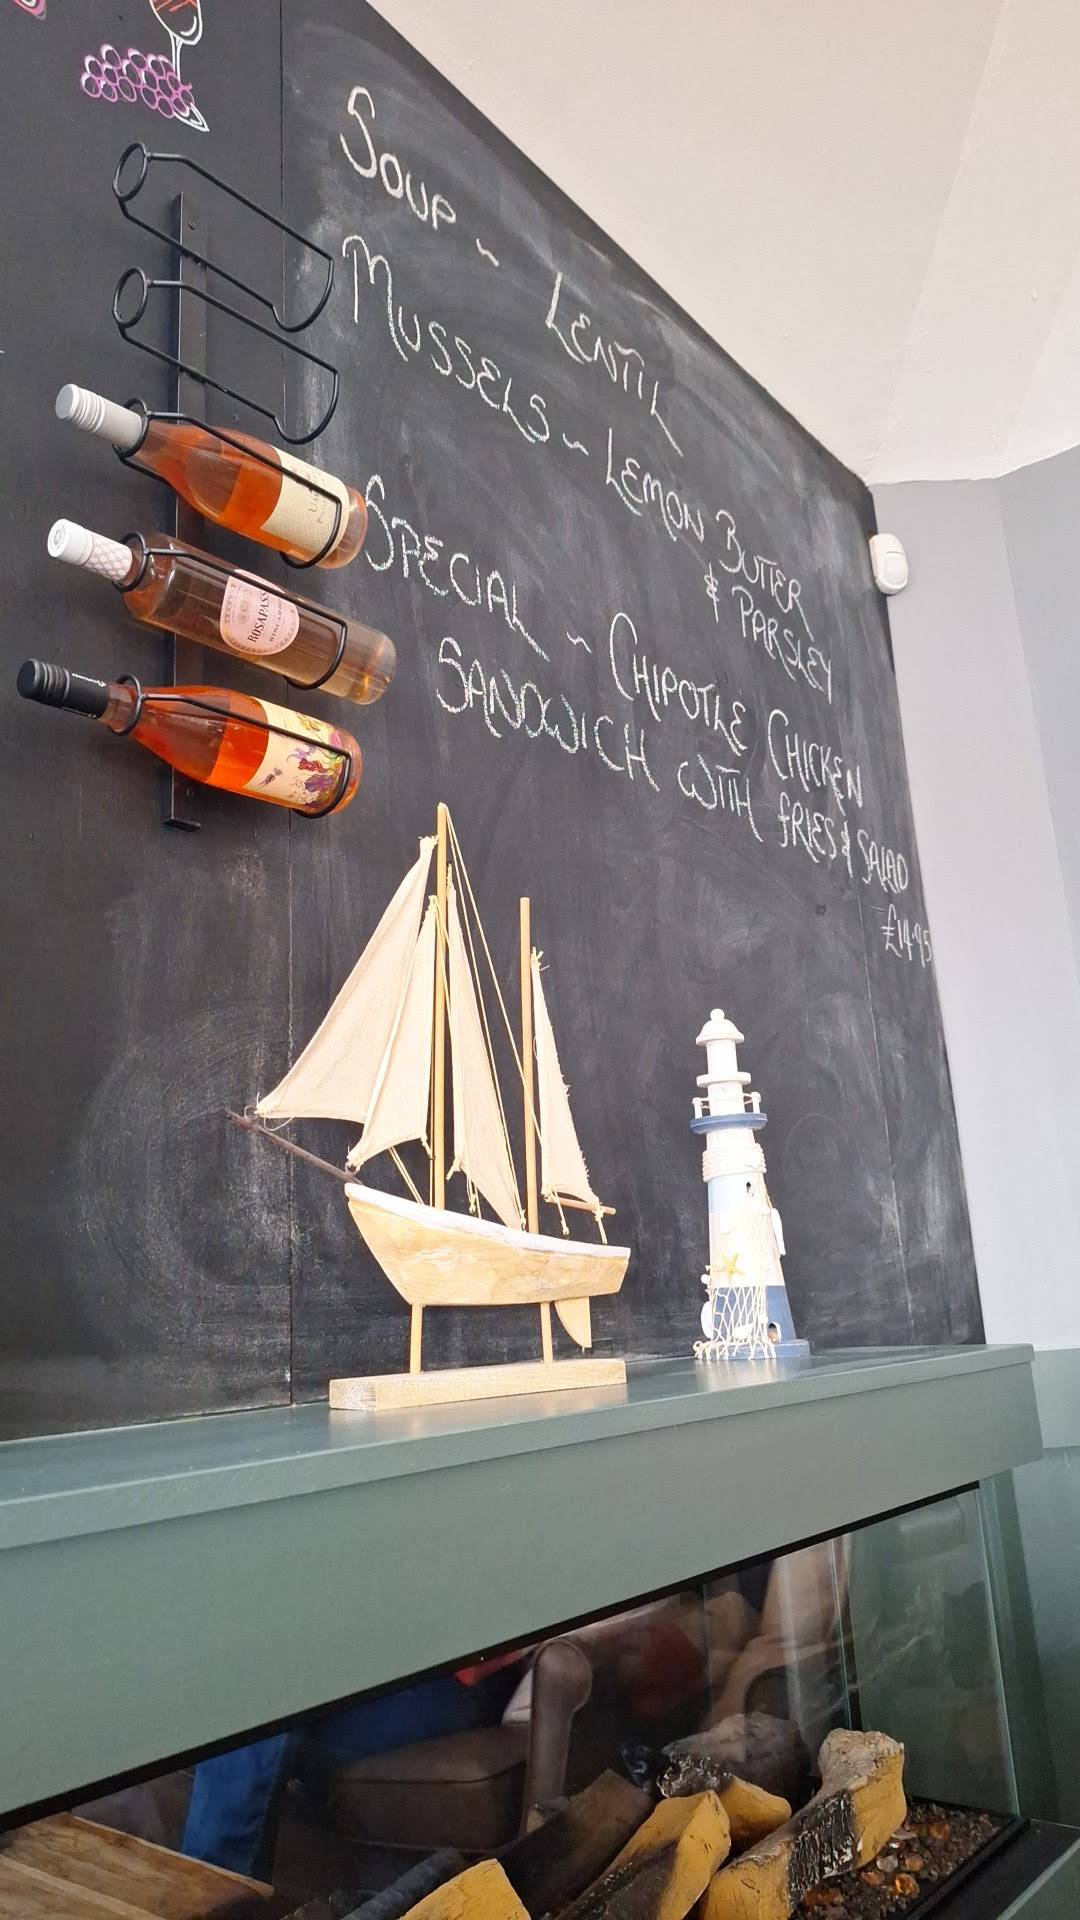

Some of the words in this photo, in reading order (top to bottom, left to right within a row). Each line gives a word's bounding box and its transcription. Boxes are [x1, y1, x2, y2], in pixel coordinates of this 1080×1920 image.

[343, 235, 550, 443] MUSSELS
[606, 428, 704, 542] LEMON
[715, 509, 814, 642] BUTTER
[545, 272, 683, 456] LENTIL
[364, 474, 550, 662] SPECIAL
[609, 612, 748, 756] CHIPOTLE
[768, 709, 863, 816] CHICKEN
[436, 637, 660, 792] SANDWICH
[677, 754, 763, 842] WITH
[857, 829, 909, 895] SALAD
[732, 585, 832, 704] PARSLEY
